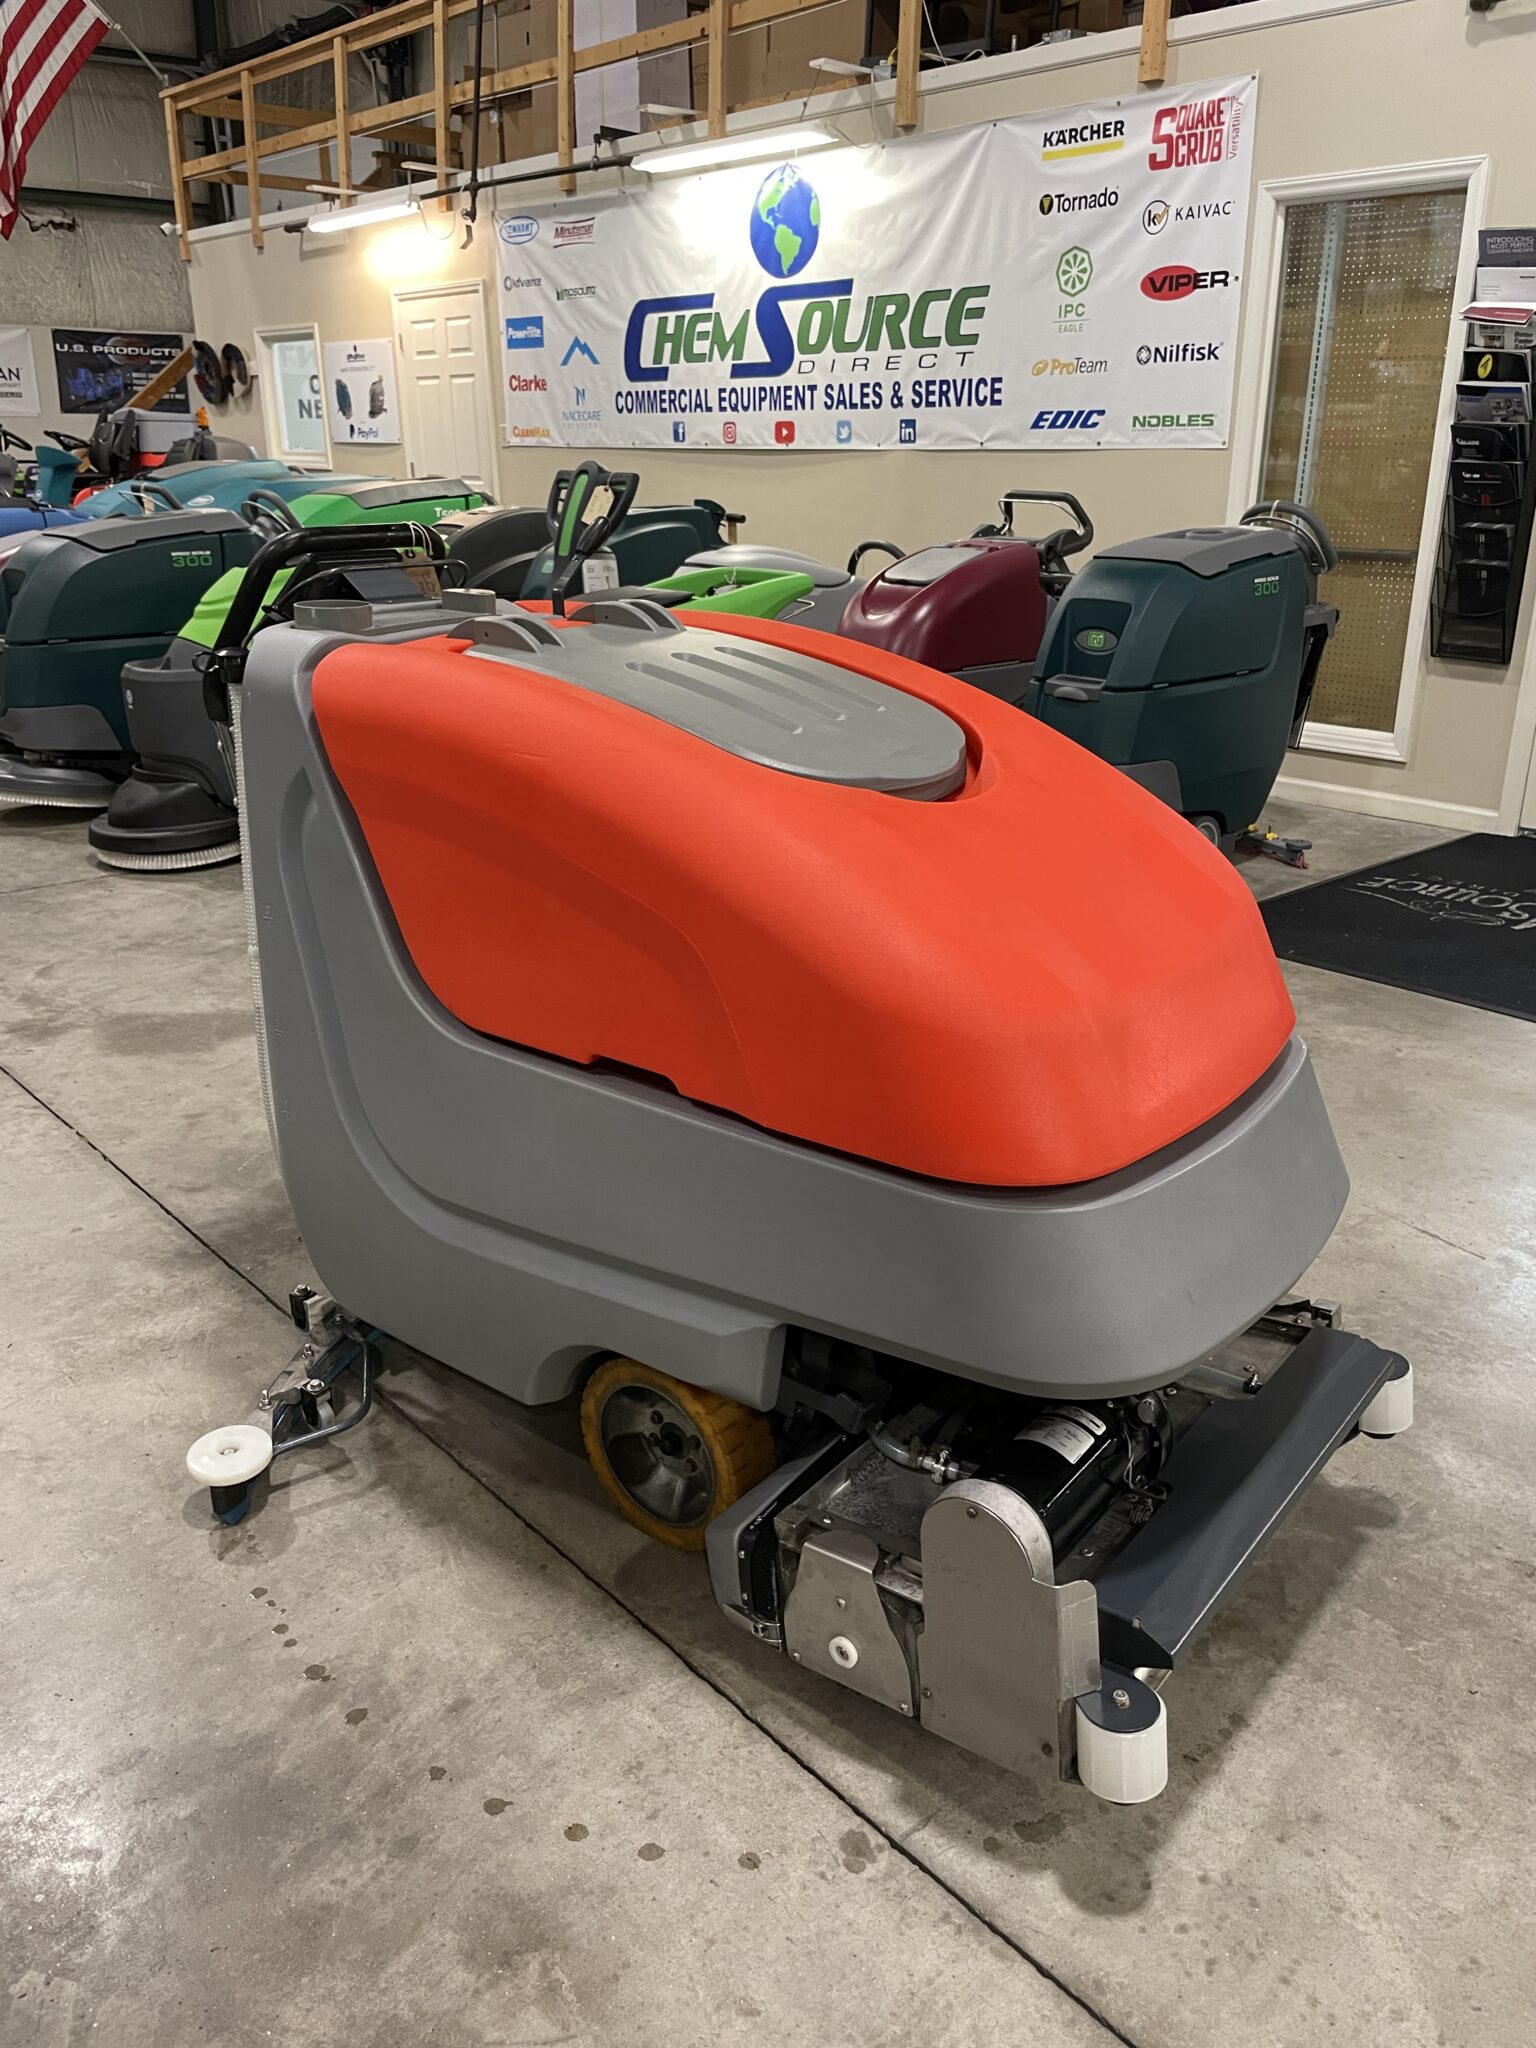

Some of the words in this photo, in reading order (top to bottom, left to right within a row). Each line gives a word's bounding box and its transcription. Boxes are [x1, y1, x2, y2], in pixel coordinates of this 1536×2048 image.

[1043, 120, 1125, 148] KÄRCHER
[1054, 187, 1119, 213] Tornado
[1175, 201, 1232, 221] KAIVAC
[1148, 270, 1230, 293] VIPER
[1058, 303, 1086, 319] IPC
[1058, 323, 1084, 333] EAGLE
[92, 345, 181, 357] PRODUCTS
[1153, 343, 1220, 363] Nilfisk
[797, 350, 974, 375] DIRECT
[1050, 357, 1108, 375] ProTeam
[509, 374, 548, 391] Clarke
[615, 389, 712, 414] COMMERCIAL
[718, 384, 817, 413] EQUIPMENT
[823, 381, 883, 410] SALES
[890, 380, 904, 409] &
[911, 376, 1003, 408] SERVICE
[1030, 409, 1106, 430] EDIC
[1132, 414, 1215, 428] NOBLES
[172, 555, 213, 568] 300
[1254, 581, 1280, 596] 300
